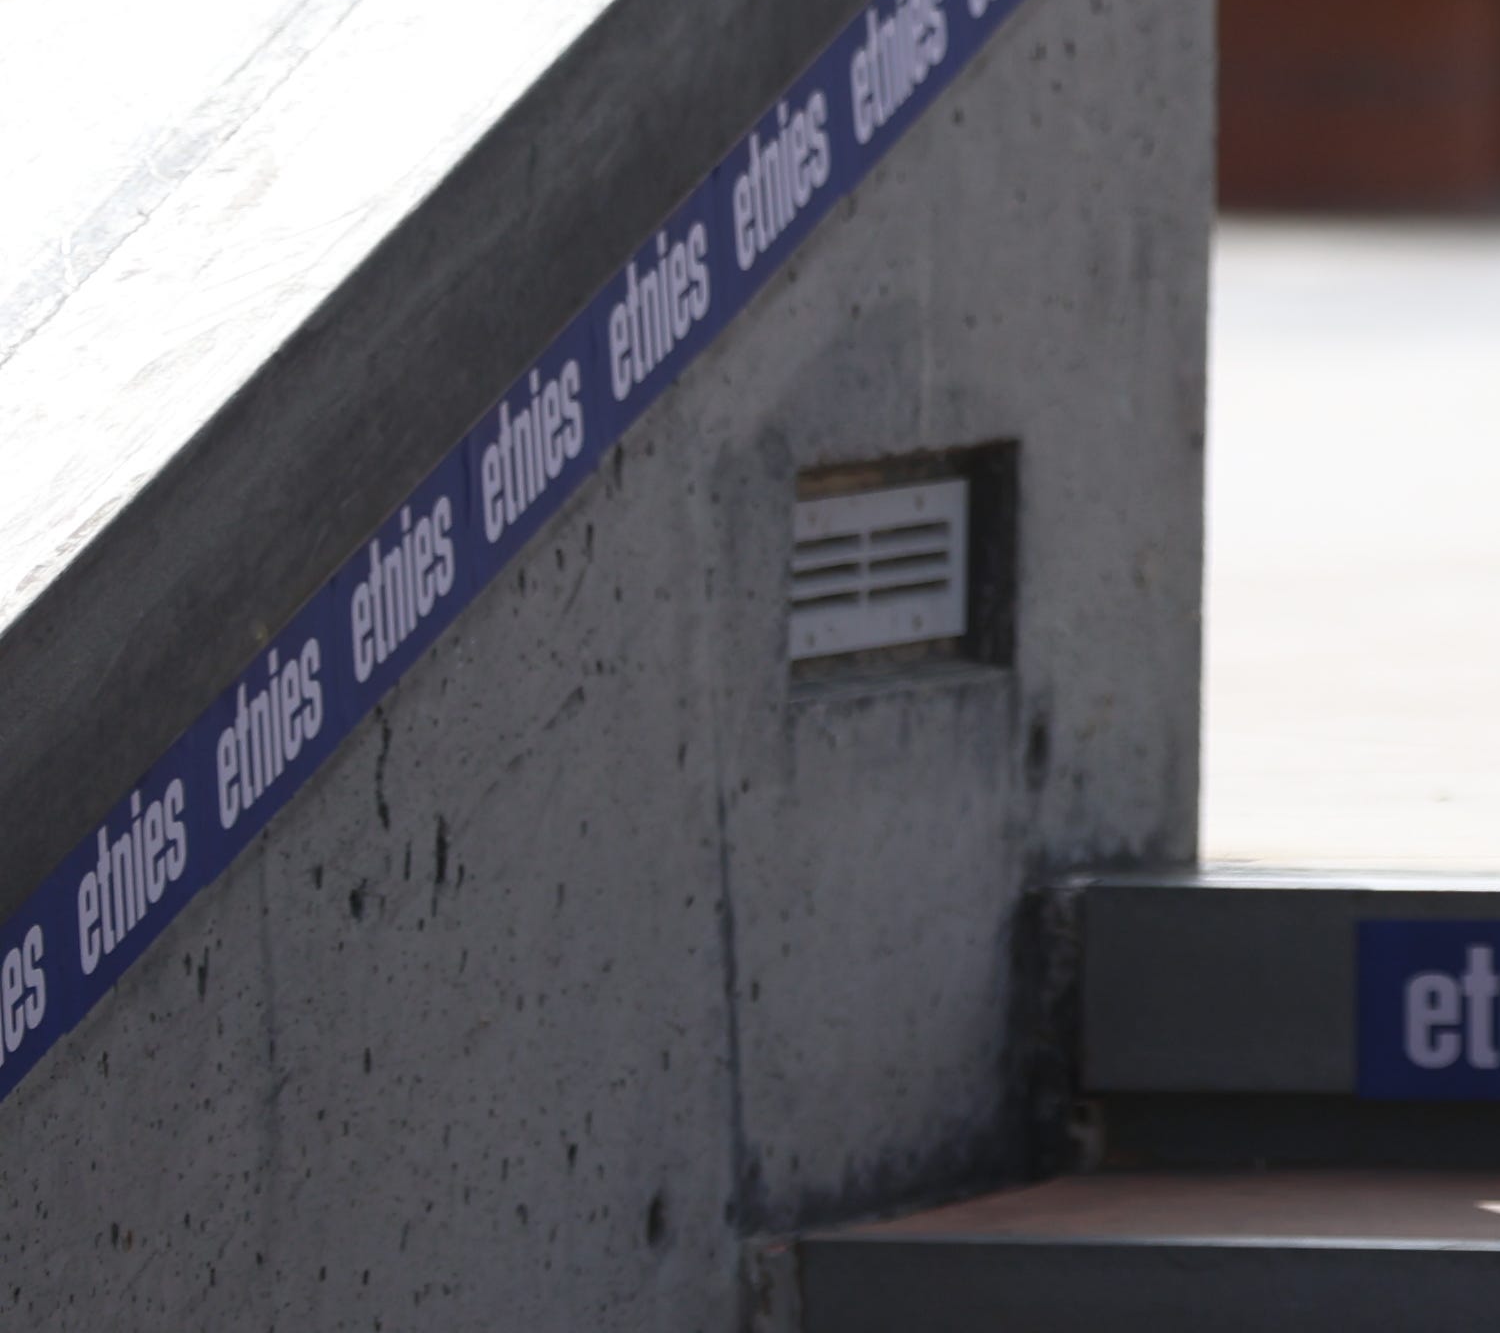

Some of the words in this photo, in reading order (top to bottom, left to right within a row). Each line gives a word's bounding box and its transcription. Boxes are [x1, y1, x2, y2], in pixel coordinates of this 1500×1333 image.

[77, 777, 188, 976] etnies
[216, 637, 324, 830] etnies
[350, 495, 455, 684] etnies
[480, 359, 584, 544] etnies
[608, 222, 710, 401] etnies
[732, 91, 831, 270] etnies
